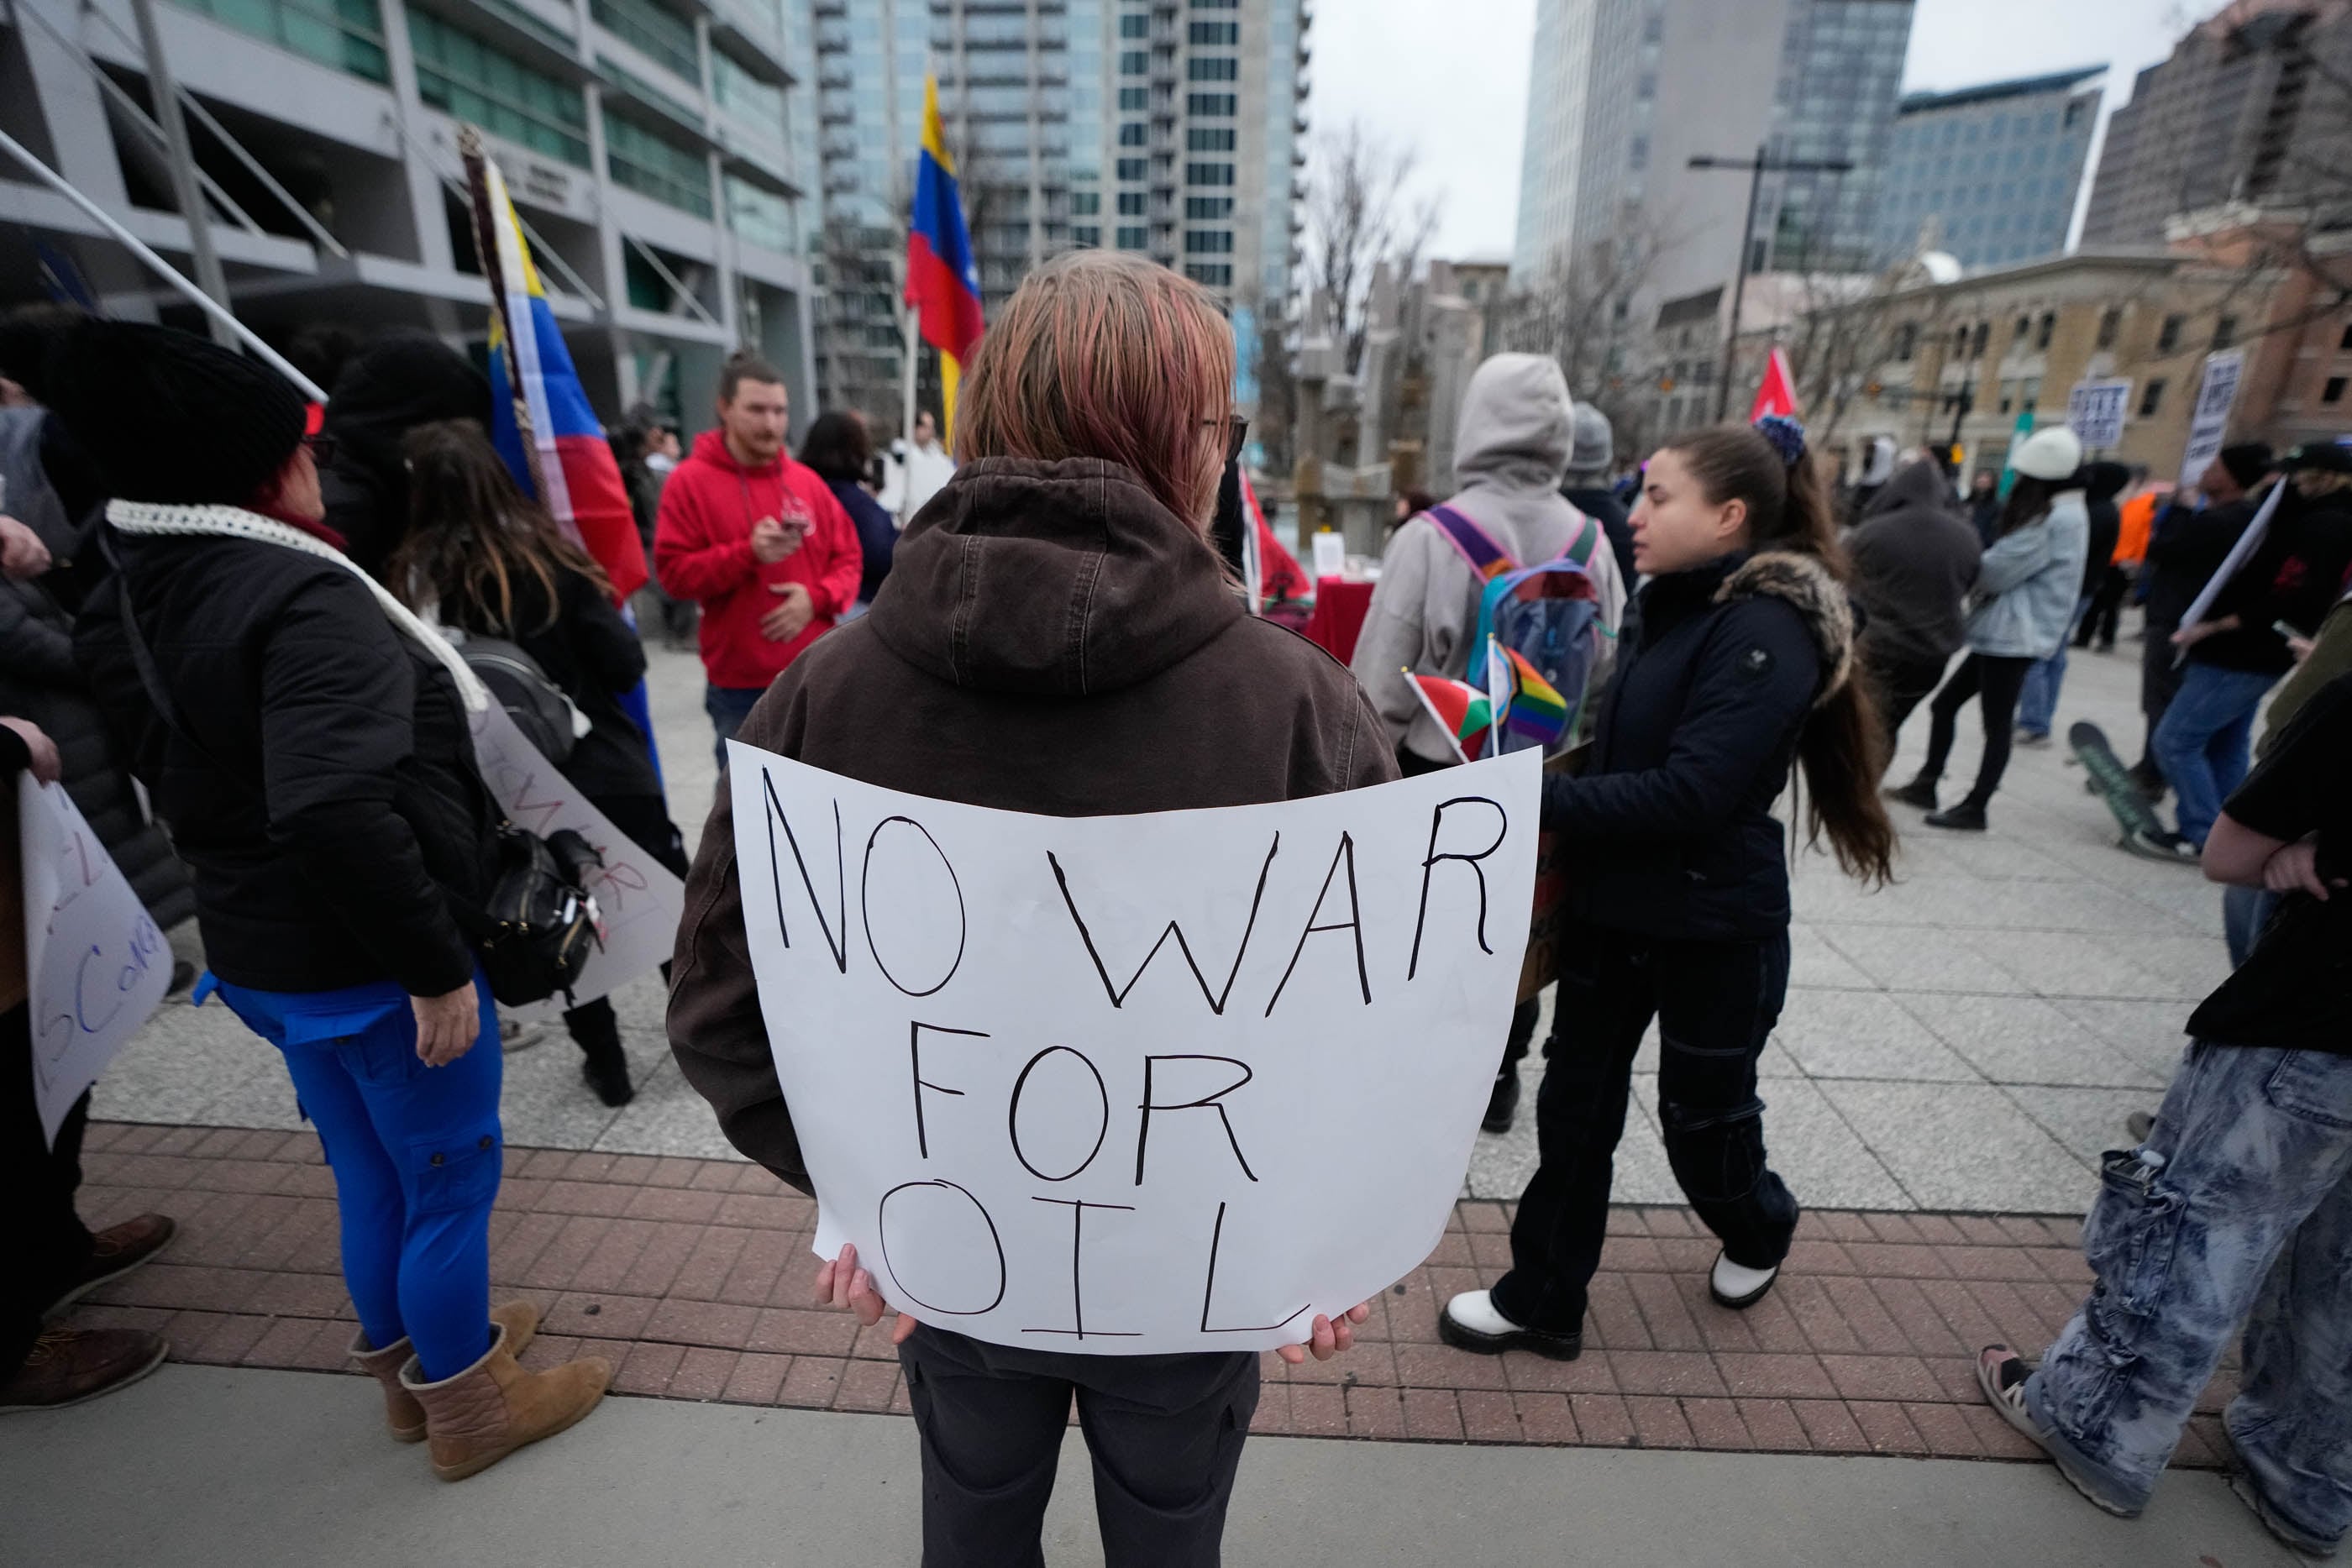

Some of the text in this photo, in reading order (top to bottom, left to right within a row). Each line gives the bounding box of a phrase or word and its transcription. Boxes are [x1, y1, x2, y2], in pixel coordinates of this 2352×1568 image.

[762, 764, 966, 998] NO
[1046, 795, 1508, 1017] WAR
[911, 1020, 1259, 1187] FOR
[879, 1178, 1311, 1341] OIL
